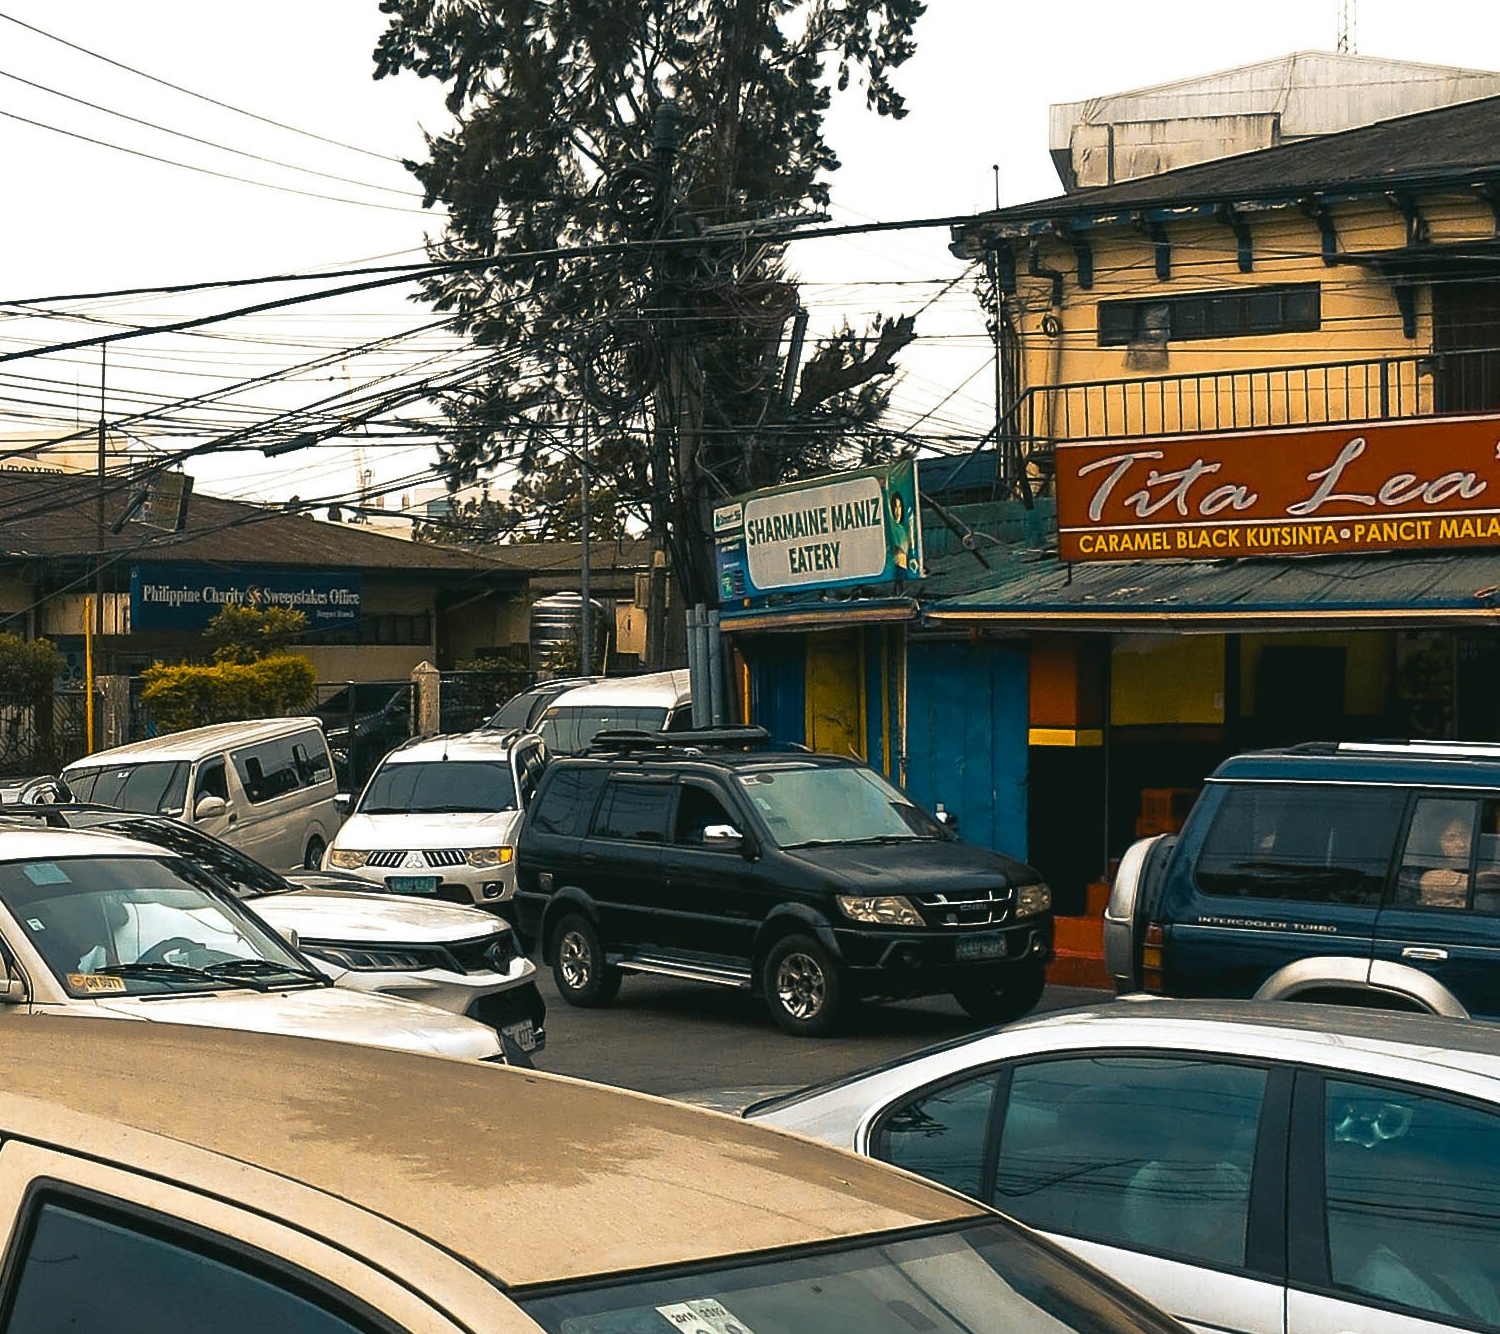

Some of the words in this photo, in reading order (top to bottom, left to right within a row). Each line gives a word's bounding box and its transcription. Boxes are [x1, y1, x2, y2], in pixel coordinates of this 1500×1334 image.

[1077, 450, 1259, 522] Tita
[747, 508, 829, 546] SHARMAINE
[830, 497, 882, 532] MANIZ
[1078, 531, 1171, 554] CARAMEL
[1177, 528, 1240, 549] BLACK
[1246, 524, 1339, 547] KUTSINTA
[1354, 519, 1432, 543] PANCIT
[1439, 516, 1500, 539] MALA
[788, 541, 841, 574] EATERY
[142, 584, 201, 607] Philippine
[203, 586, 244, 608] Charity
[263, 586, 328, 609] Sweepstakes
[329, 588, 361, 605] Office
[1198, 915, 1288, 930] INTERCOOLER
[1291, 922, 1338, 933] TURBO
